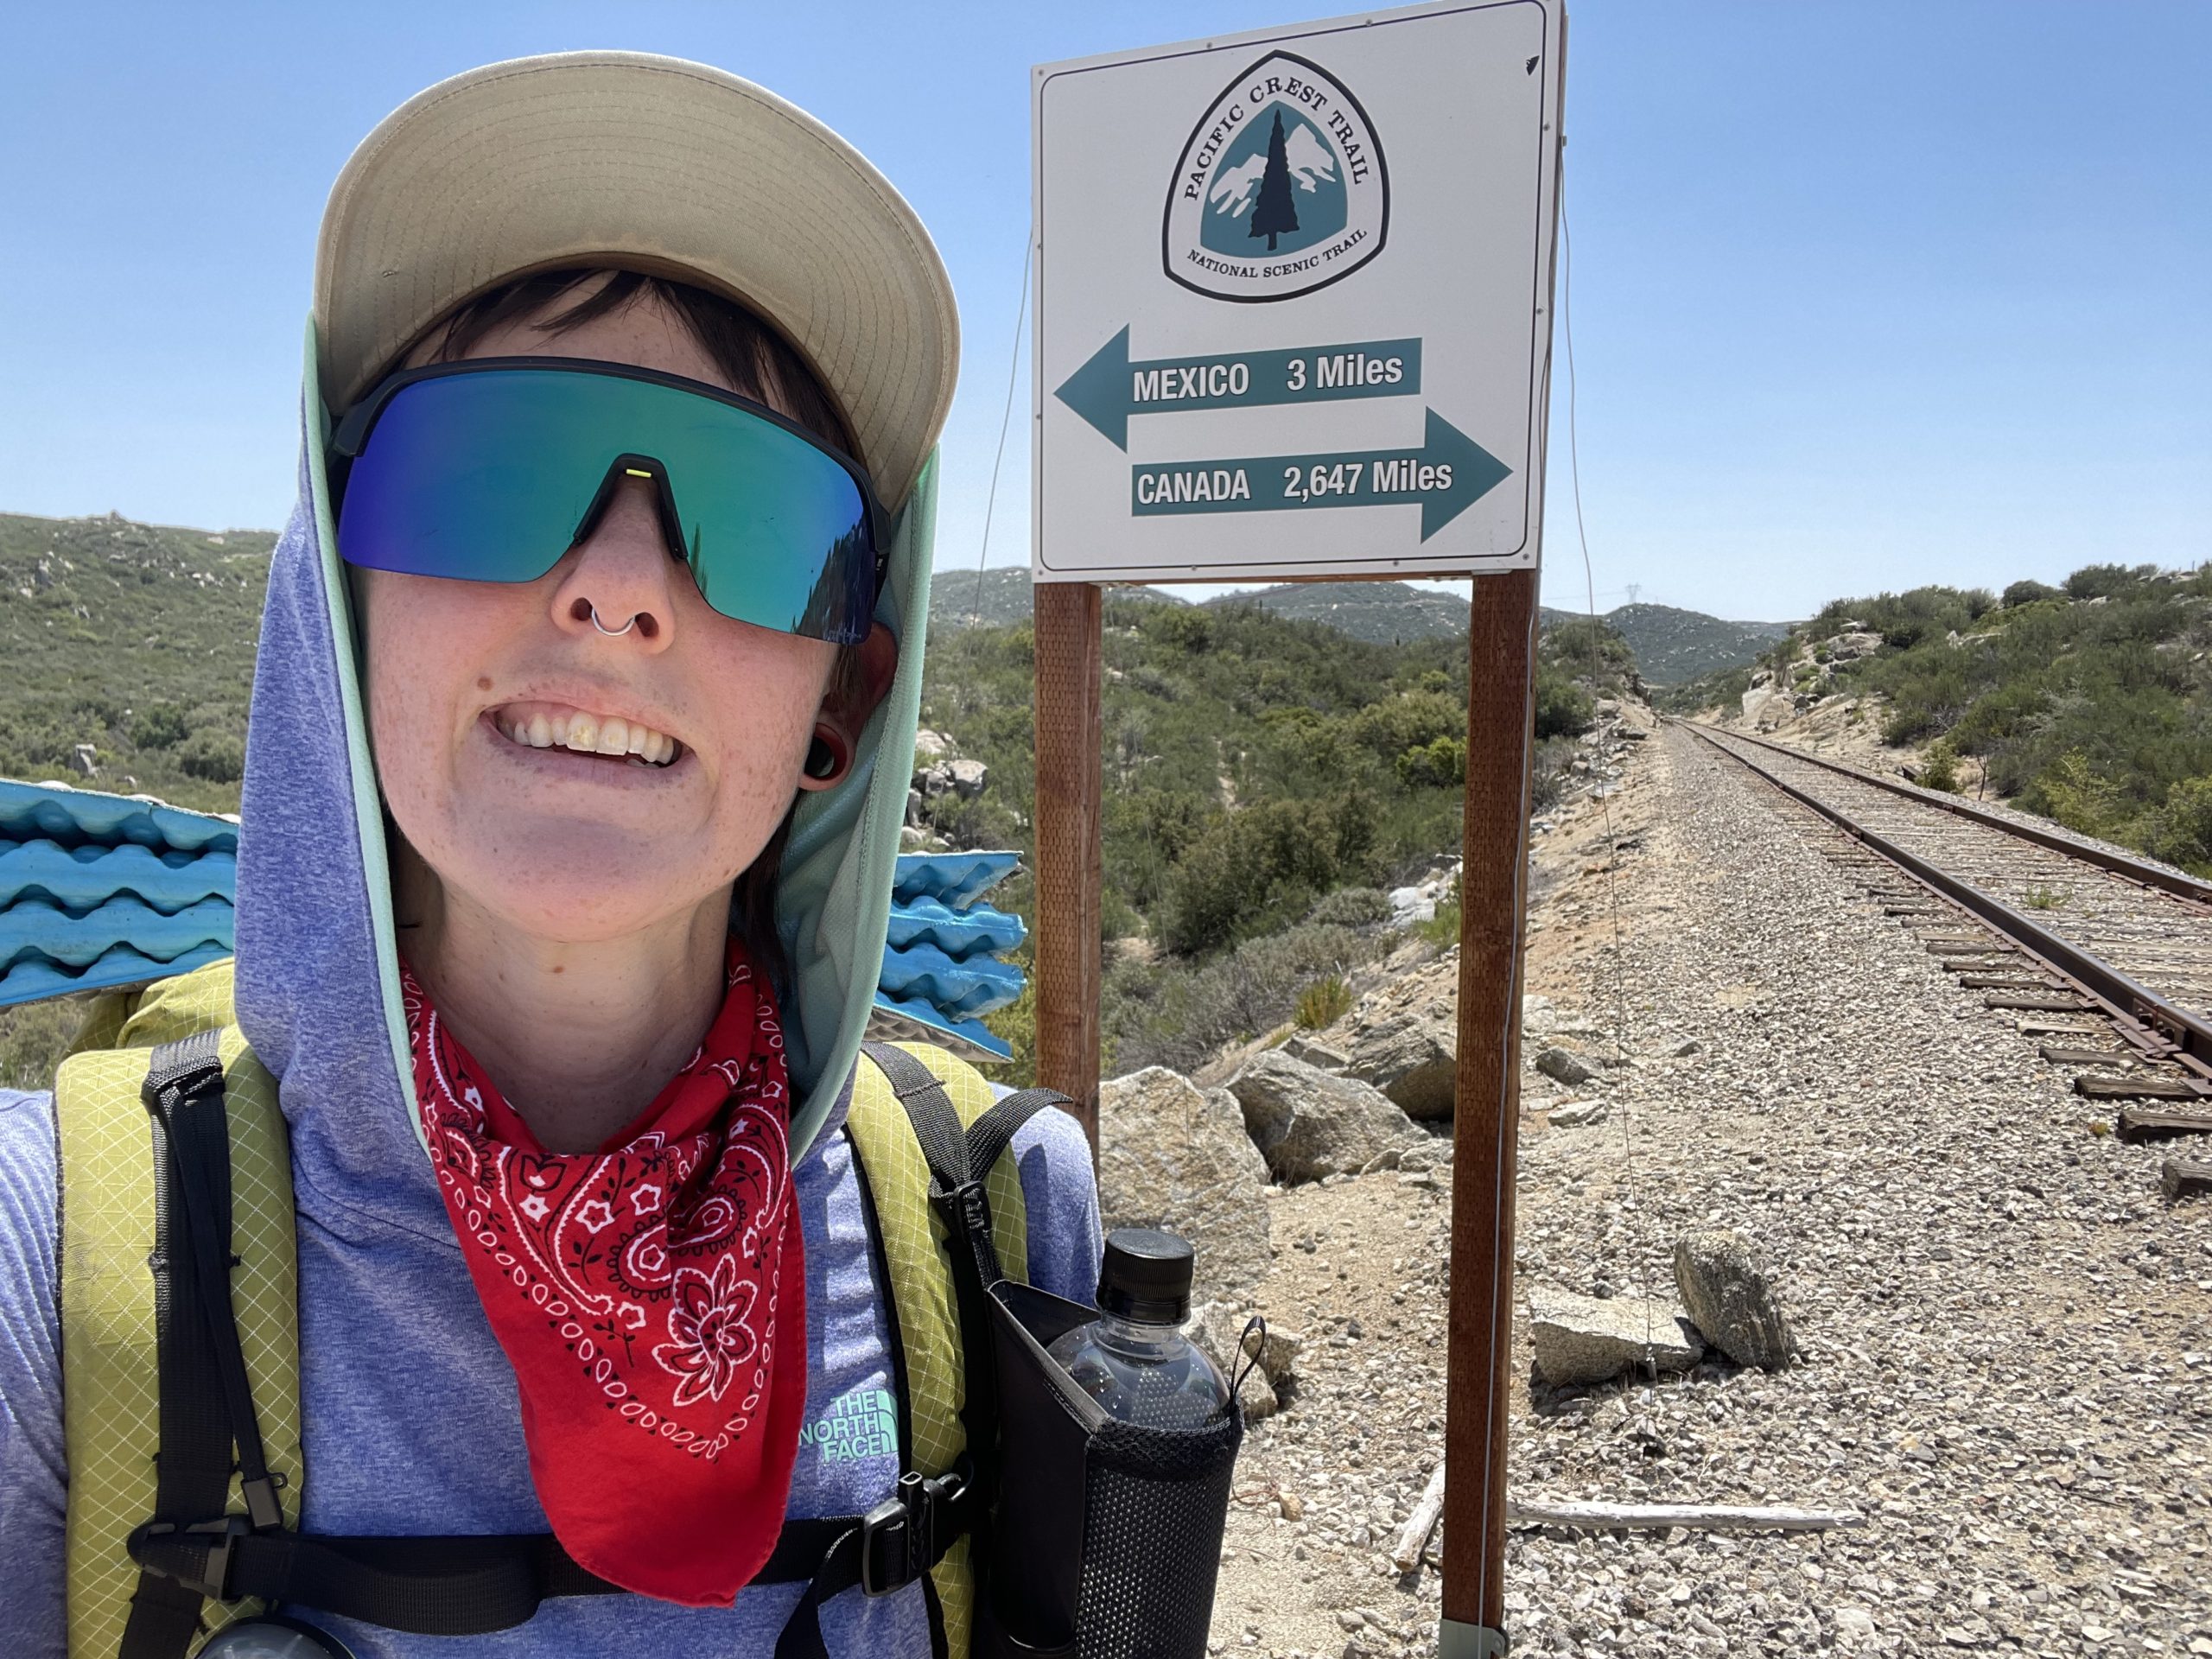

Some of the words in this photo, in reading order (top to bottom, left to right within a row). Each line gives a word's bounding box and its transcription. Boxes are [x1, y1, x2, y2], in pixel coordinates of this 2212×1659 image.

[1184, 104, 1244, 201] PACIFIC
[1249, 76, 1328, 111] CREST
[1327, 110, 1370, 185] TRAIL
[1187, 249, 1258, 277] NATIONAL
[1263, 256, 1319, 277] SCENIC
[1322, 228, 1368, 262] TRAIL
[1133, 362, 1250, 404] MEXICO
[1287, 359, 1307, 391] 3
[1316, 353, 1403, 389] Miles
[1137, 469, 1251, 505] CANADA
[1283, 463, 1363, 504] 2,647
[1371, 459, 1453, 493] Miles
[830, 1390, 878, 1417] THE
[798, 1411, 880, 1447] NORTH
[823, 1433, 881, 1464] FACE
